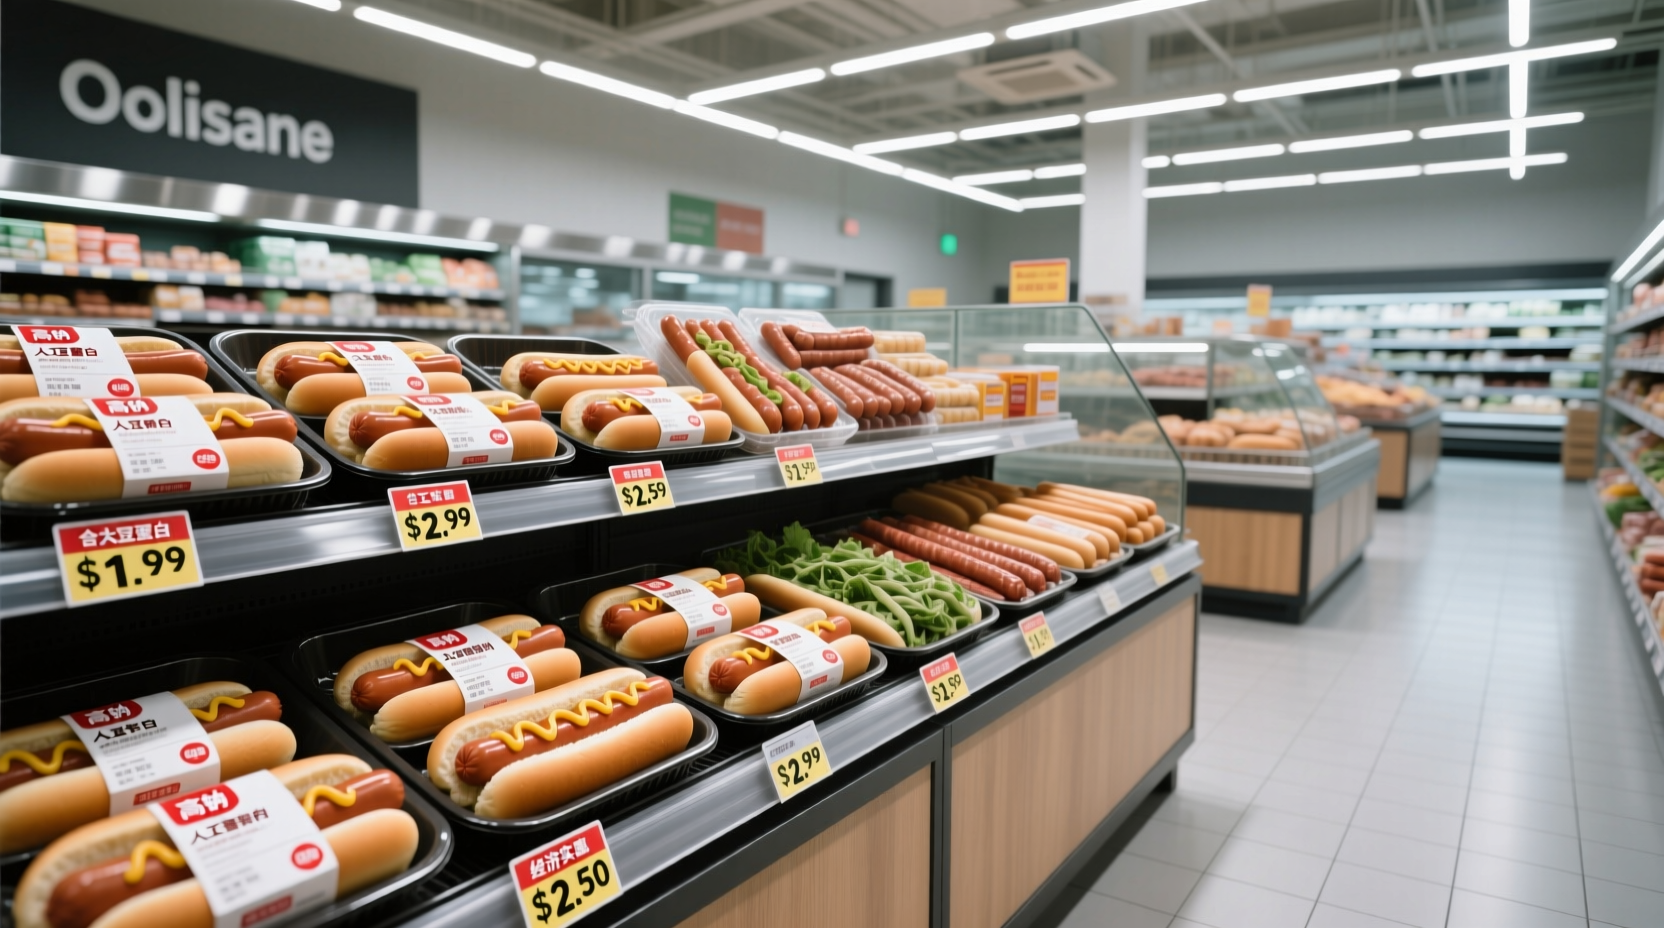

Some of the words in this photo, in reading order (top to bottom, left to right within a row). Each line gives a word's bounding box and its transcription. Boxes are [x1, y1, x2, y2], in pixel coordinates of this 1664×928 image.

[59, 58, 334, 164] Oolisane
[622, 482, 666, 508] $2.59
[405, 507, 471, 541] $2.99
[77, 546, 186, 592] $1.99
[777, 747, 820, 787] $2.99
[532, 859, 610, 924] $2.50
